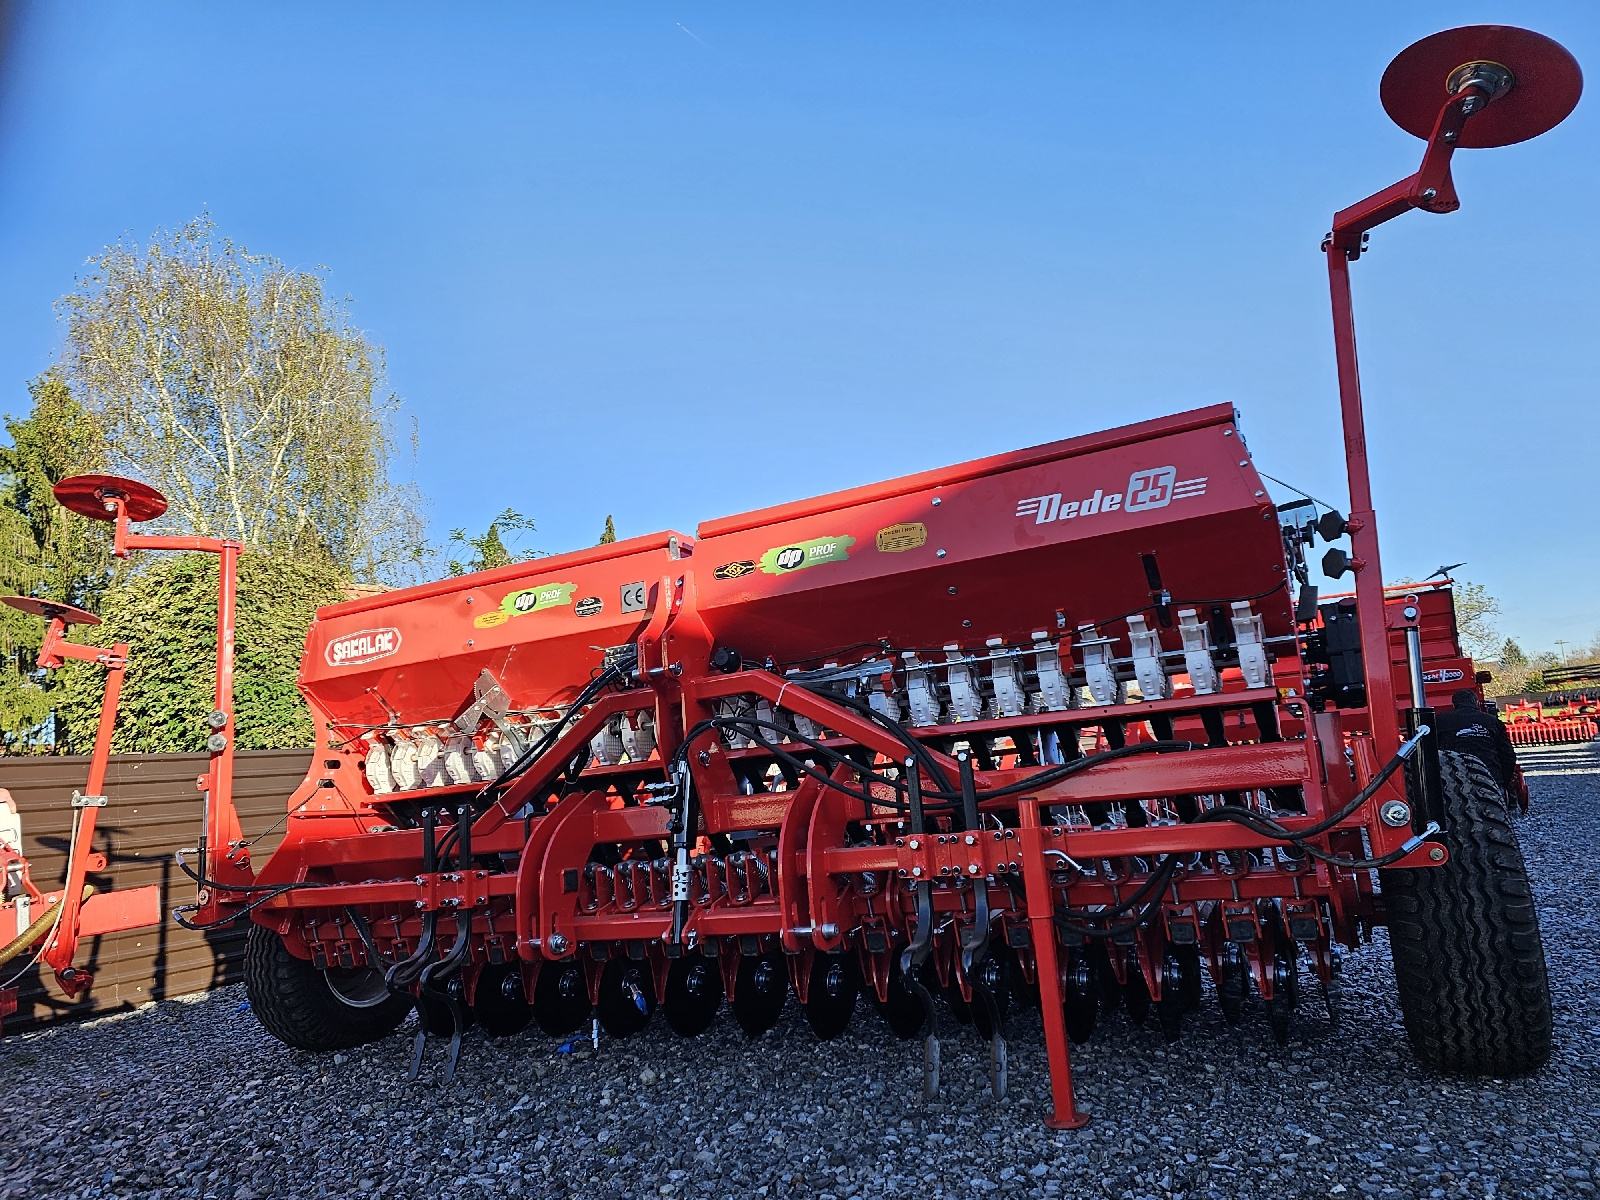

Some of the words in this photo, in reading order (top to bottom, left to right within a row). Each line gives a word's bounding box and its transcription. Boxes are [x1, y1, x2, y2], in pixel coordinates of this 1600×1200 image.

[1035, 489, 1122, 524] Dede
[1127, 468, 1174, 510] 25
[809, 542, 838, 557] PROF
[540, 588, 562, 601] PROF
[623, 587, 643, 607] CE
